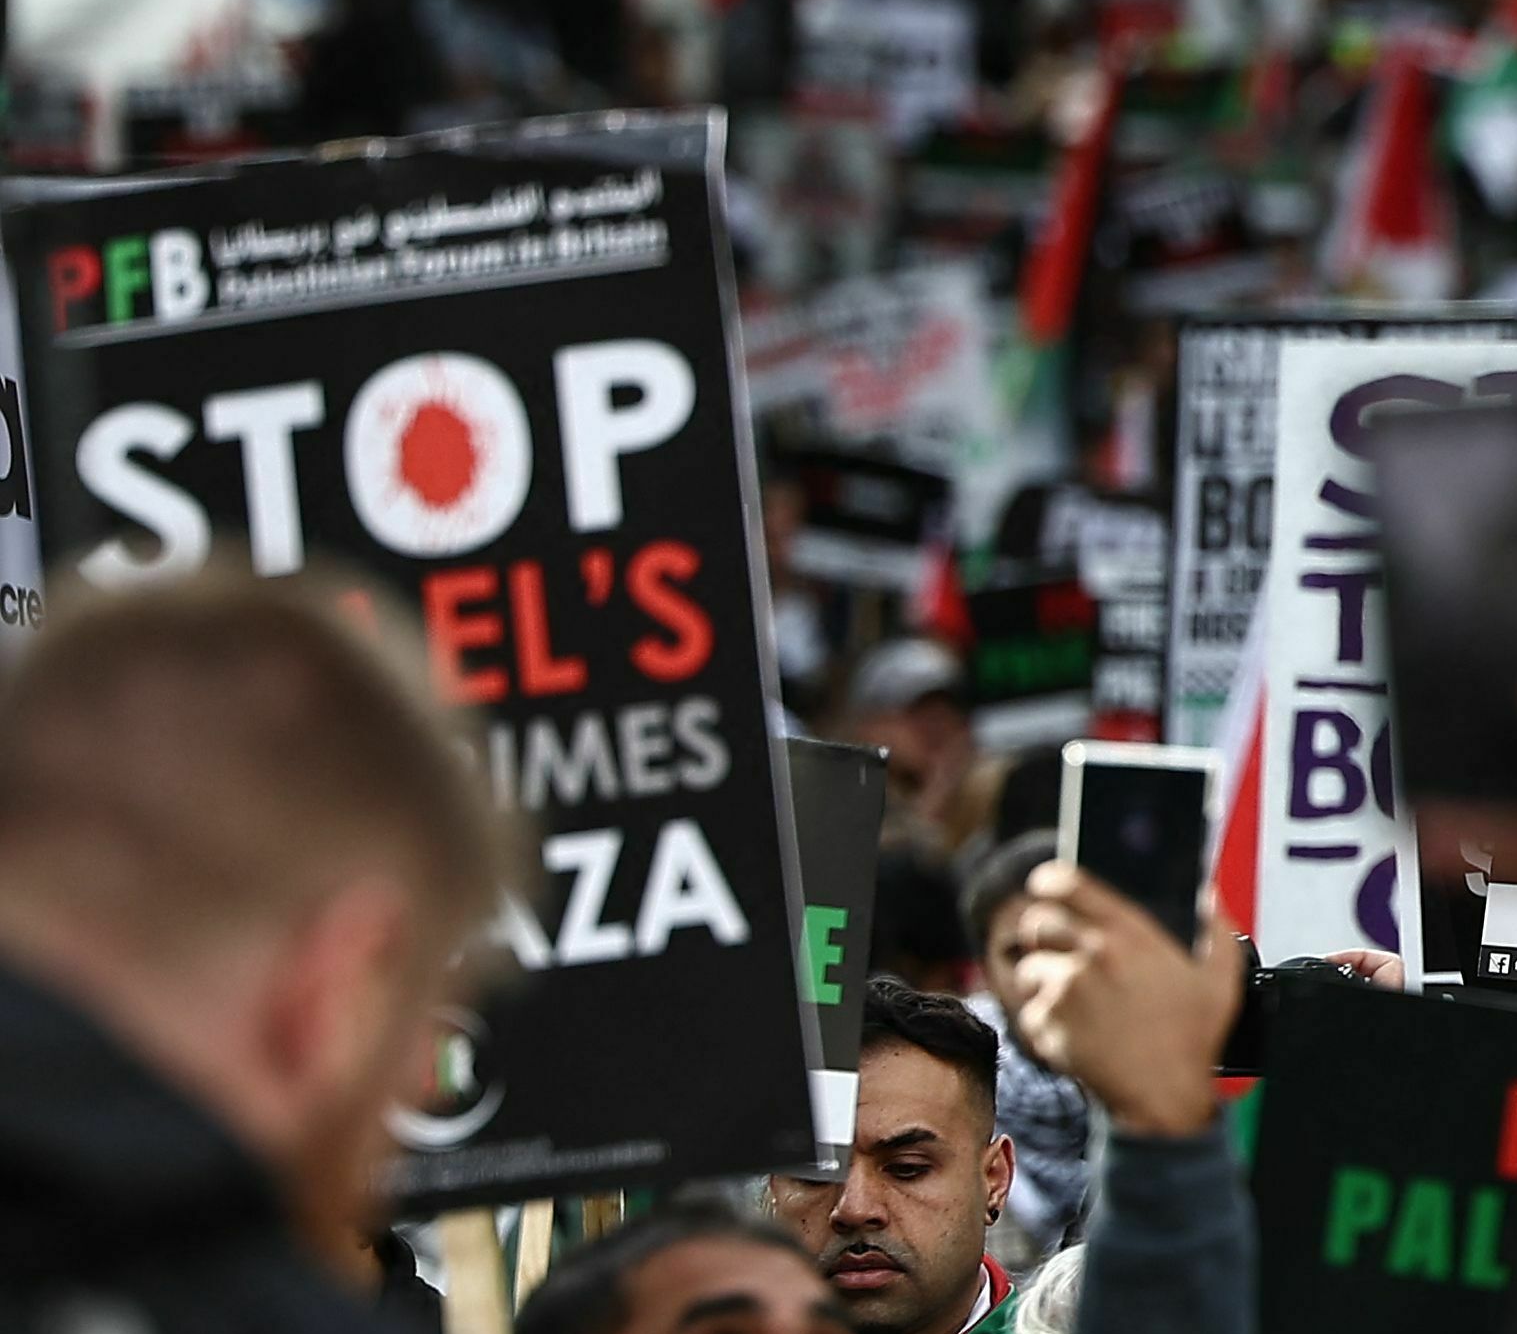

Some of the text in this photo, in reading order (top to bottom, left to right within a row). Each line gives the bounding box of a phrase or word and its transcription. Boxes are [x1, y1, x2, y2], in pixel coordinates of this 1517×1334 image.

[45, 225, 208, 335] PFB
[76, 337, 697, 597] STOP
[420, 539, 715, 707] EL'S
[490, 695, 731, 809] IMES
[505, 817, 752, 971] ZA
